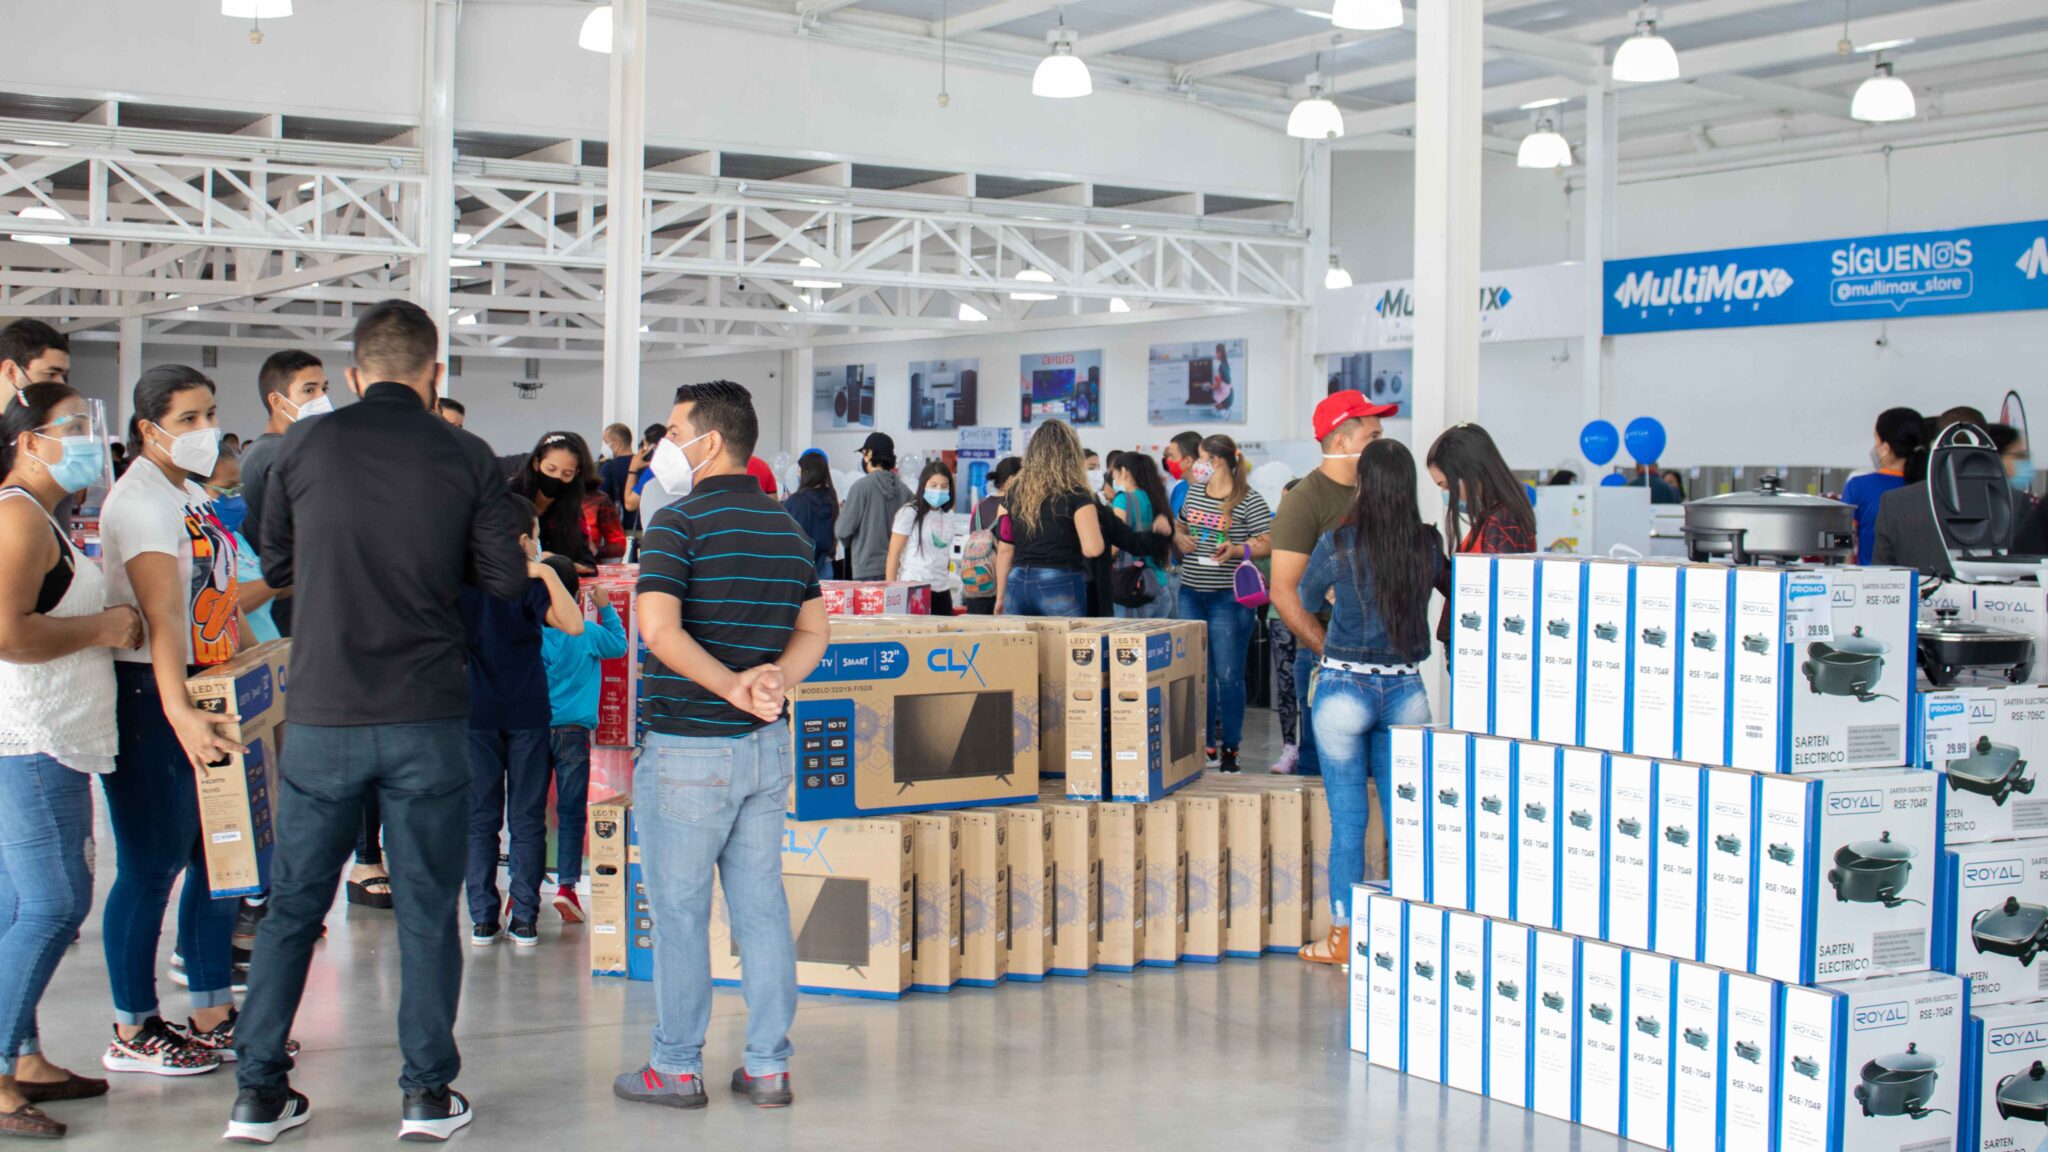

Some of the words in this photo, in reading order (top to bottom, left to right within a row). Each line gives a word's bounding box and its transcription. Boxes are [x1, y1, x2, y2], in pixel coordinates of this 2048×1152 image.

[1621, 263, 1780, 309] MultiMax
[1837, 276, 1962, 300] @multimax_store
[1791, 585, 1825, 593] PROMO
[1692, 601, 1719, 610] ROYAL
[1866, 596, 1900, 605] RSE-704R
[1984, 600, 2035, 612] ROYAL
[1742, 605, 1773, 614] ROYAL
[1789, 625, 1794, 637] $
[1808, 625, 1829, 636] 29.99
[842, 657, 869, 667] SMART
[880, 650, 900, 663] 32"
[1459, 648, 1483, 657] RSE-704R
[1501, 652, 1527, 661] RSE-704R
[927, 643, 987, 688] CLX
[1545, 656, 1572, 665] RSE-704R
[1592, 660, 1620, 670] RSE-704R
[1640, 666, 1669, 676] RSE-704R
[1689, 670, 1719, 680] RSE-704R
[1740, 674, 1772, 685] RSE-704R
[192, 684, 212, 693] LED
[215, 683, 228, 691] TV
[1930, 704, 1962, 713] PROMO
[2012, 710, 2045, 720] RSE-705C
[1795, 735, 1829, 748] SARTEN
[1929, 744, 1934, 755] $
[1947, 743, 1967, 754] 29.99
[1795, 751, 1845, 765] ELECTRICO
[1908, 785, 1933, 793] ELECTRICO
[1830, 797, 1880, 810] ROYAL
[1894, 798, 1928, 809] RSE-704R
[1946, 809, 1963, 818] RTEN
[1945, 821, 1976, 832] CTRICO
[1523, 838, 1549, 849] RSE-704R
[1568, 847, 1595, 857] RSE-704R
[1615, 855, 1644, 866] RSE-704R
[1663, 864, 1692, 875] RSE-704R
[1967, 866, 2020, 881] ROYAL
[1713, 873, 1744, 885] RSE-704R
[1765, 882, 1797, 895] RSE-704R
[1819, 942, 1854, 957] SARTEN
[1819, 958, 1869, 974] ELECTRICO
[1971, 982, 2000, 995] CTRICO
[1933, 993, 1958, 1002] ELECTRICO
[1856, 1006, 1906, 1025] ROYAL
[1919, 1006, 1953, 1020] RSE-704R
[1540, 1027, 1567, 1040] RSE-704R
[1793, 1024, 1824, 1039] ROYAL
[1991, 1030, 2047, 1047] ROYAL
[1587, 1039, 1615, 1052] RSE-704R
[1633, 1052, 1663, 1065] RSE-704R
[1681, 1065, 1712, 1079] RSE-704R
[1732, 1079, 1764, 1094] RSE-704R
[1788, 1094, 1821, 1111] RSE-704R
[1984, 1137, 2014, 1149] SARTEN
